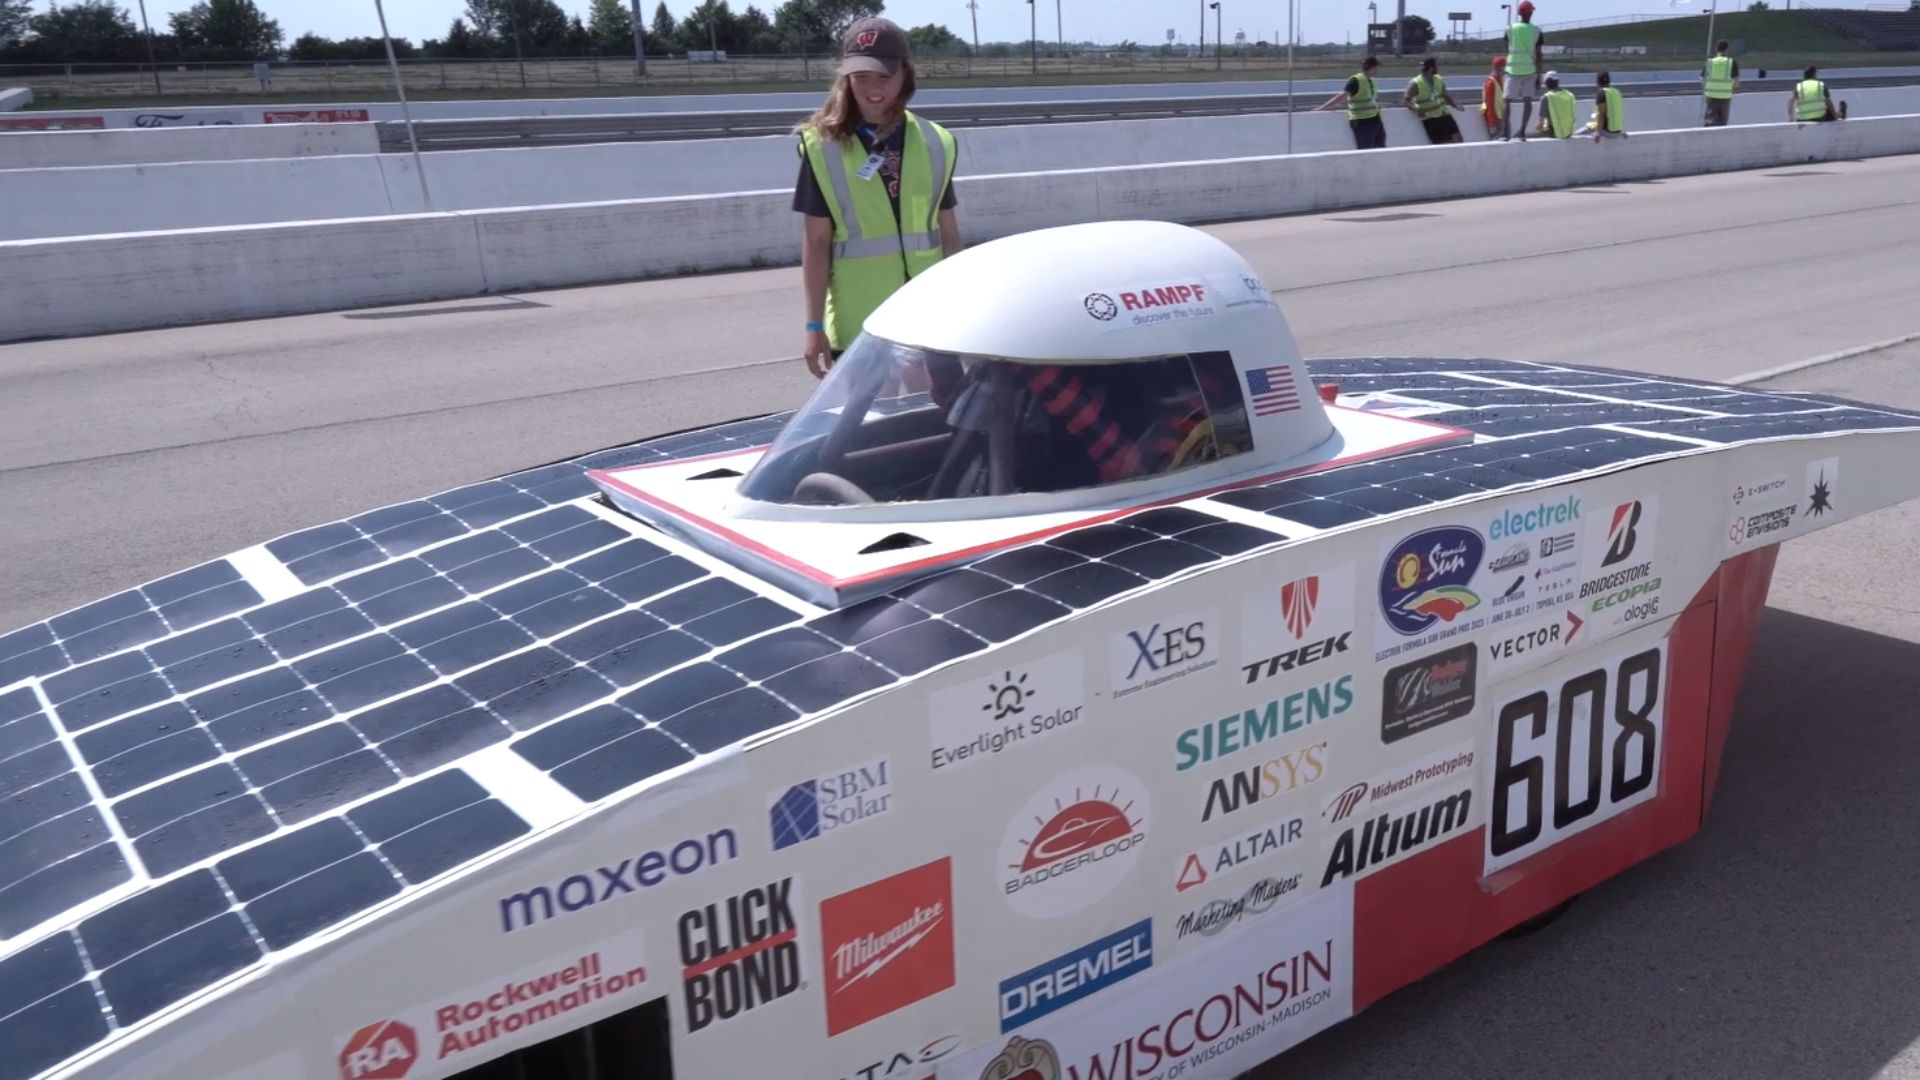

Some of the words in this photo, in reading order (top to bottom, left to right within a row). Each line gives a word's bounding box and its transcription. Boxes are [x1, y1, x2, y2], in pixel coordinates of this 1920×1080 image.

[1119, 284, 1205, 311] RAMPF
[1132, 312, 1172, 326] discover
[1173, 309, 1187, 320] the
[1188, 306, 1215, 318] future
[1489, 494, 1582, 541] electrek
[1579, 561, 1652, 599] BRIDGESTONE
[1592, 577, 1662, 612] ECOPIA
[1125, 621, 1206, 680] X-ES
[1241, 630, 1353, 685] TREK
[1490, 624, 1560, 661] VECTOR
[931, 723, 1025, 770] Everlight
[1030, 705, 1084, 735] Solar
[1176, 674, 1354, 772] SIEMENS
[1490, 647, 1661, 858] 608
[820, 760, 888, 805] SBM
[1201, 742, 1325, 823] ANSYS
[1370, 774, 1413, 802] Midwest
[1414, 752, 1474, 784] Prototyping
[821, 793, 892, 832] Solar
[1215, 818, 1303, 872] ALTAIR
[1320, 788, 1472, 889] Altium
[500, 828, 738, 934] maxeon
[1005, 833, 1145, 895] BADGERLOOP
[678, 876, 796, 967] CLICK
[1176, 897, 1246, 939] Marketing
[1250, 874, 1301, 906] Masters
[831, 900, 944, 980] Milwaukee
[435, 952, 601, 1033] Rockwell
[683, 940, 800, 1034] BOND
[1001, 934, 1152, 1021] DREMEL
[1067, 939, 1333, 1080] WISCONSIN
[437, 966, 646, 1060] Automation
[1167, 1058, 1188, 1080] OF
[1189, 987, 1332, 1069] WISCONSIN-MADISON
[345, 1036, 412, 1079] RA
